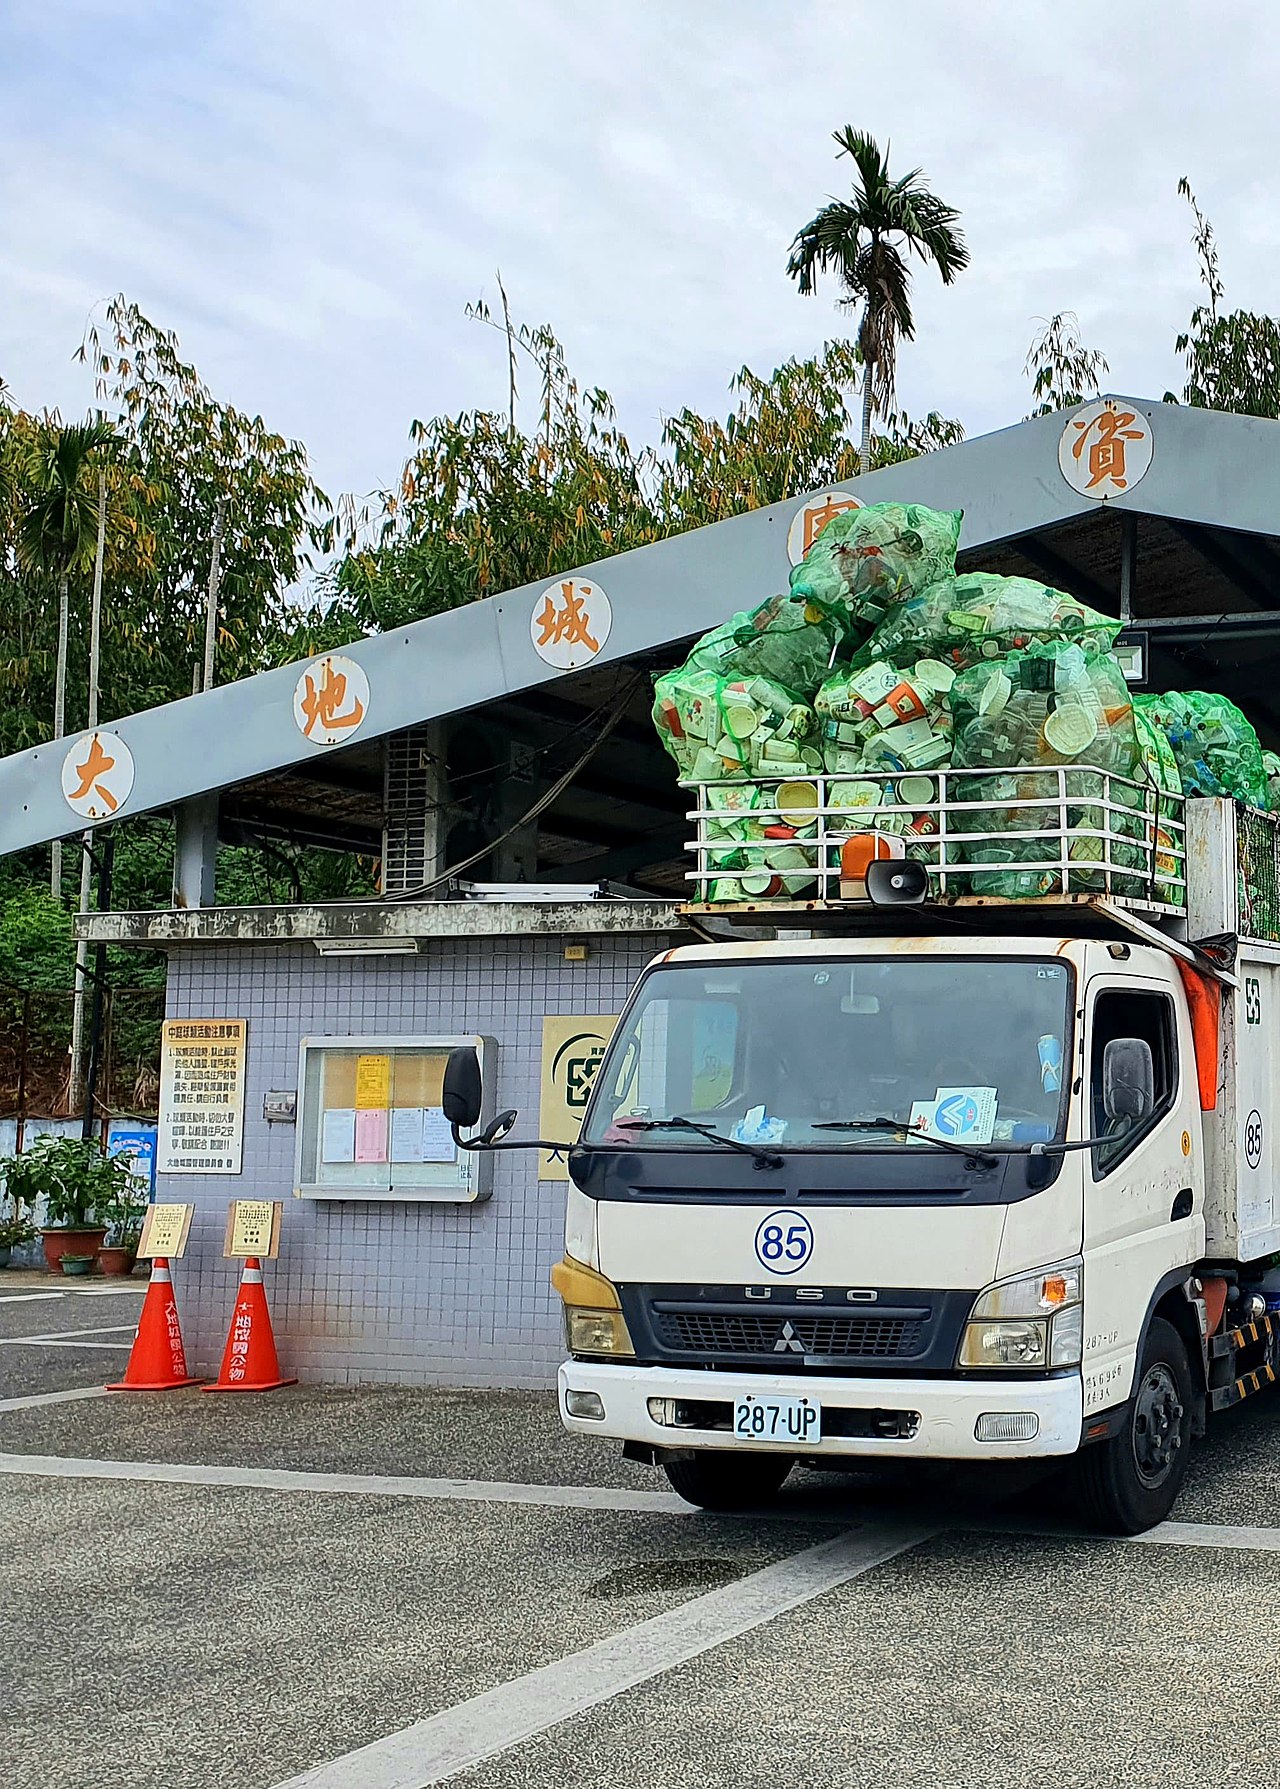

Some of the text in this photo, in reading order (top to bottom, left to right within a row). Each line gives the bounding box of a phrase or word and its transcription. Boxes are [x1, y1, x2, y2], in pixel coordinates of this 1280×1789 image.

[1246, 1122, 1261, 1157] 85
[761, 1224, 808, 1261] 85
[745, 1286, 879, 1302] USO
[736, 1402, 817, 1437] 287-UP
